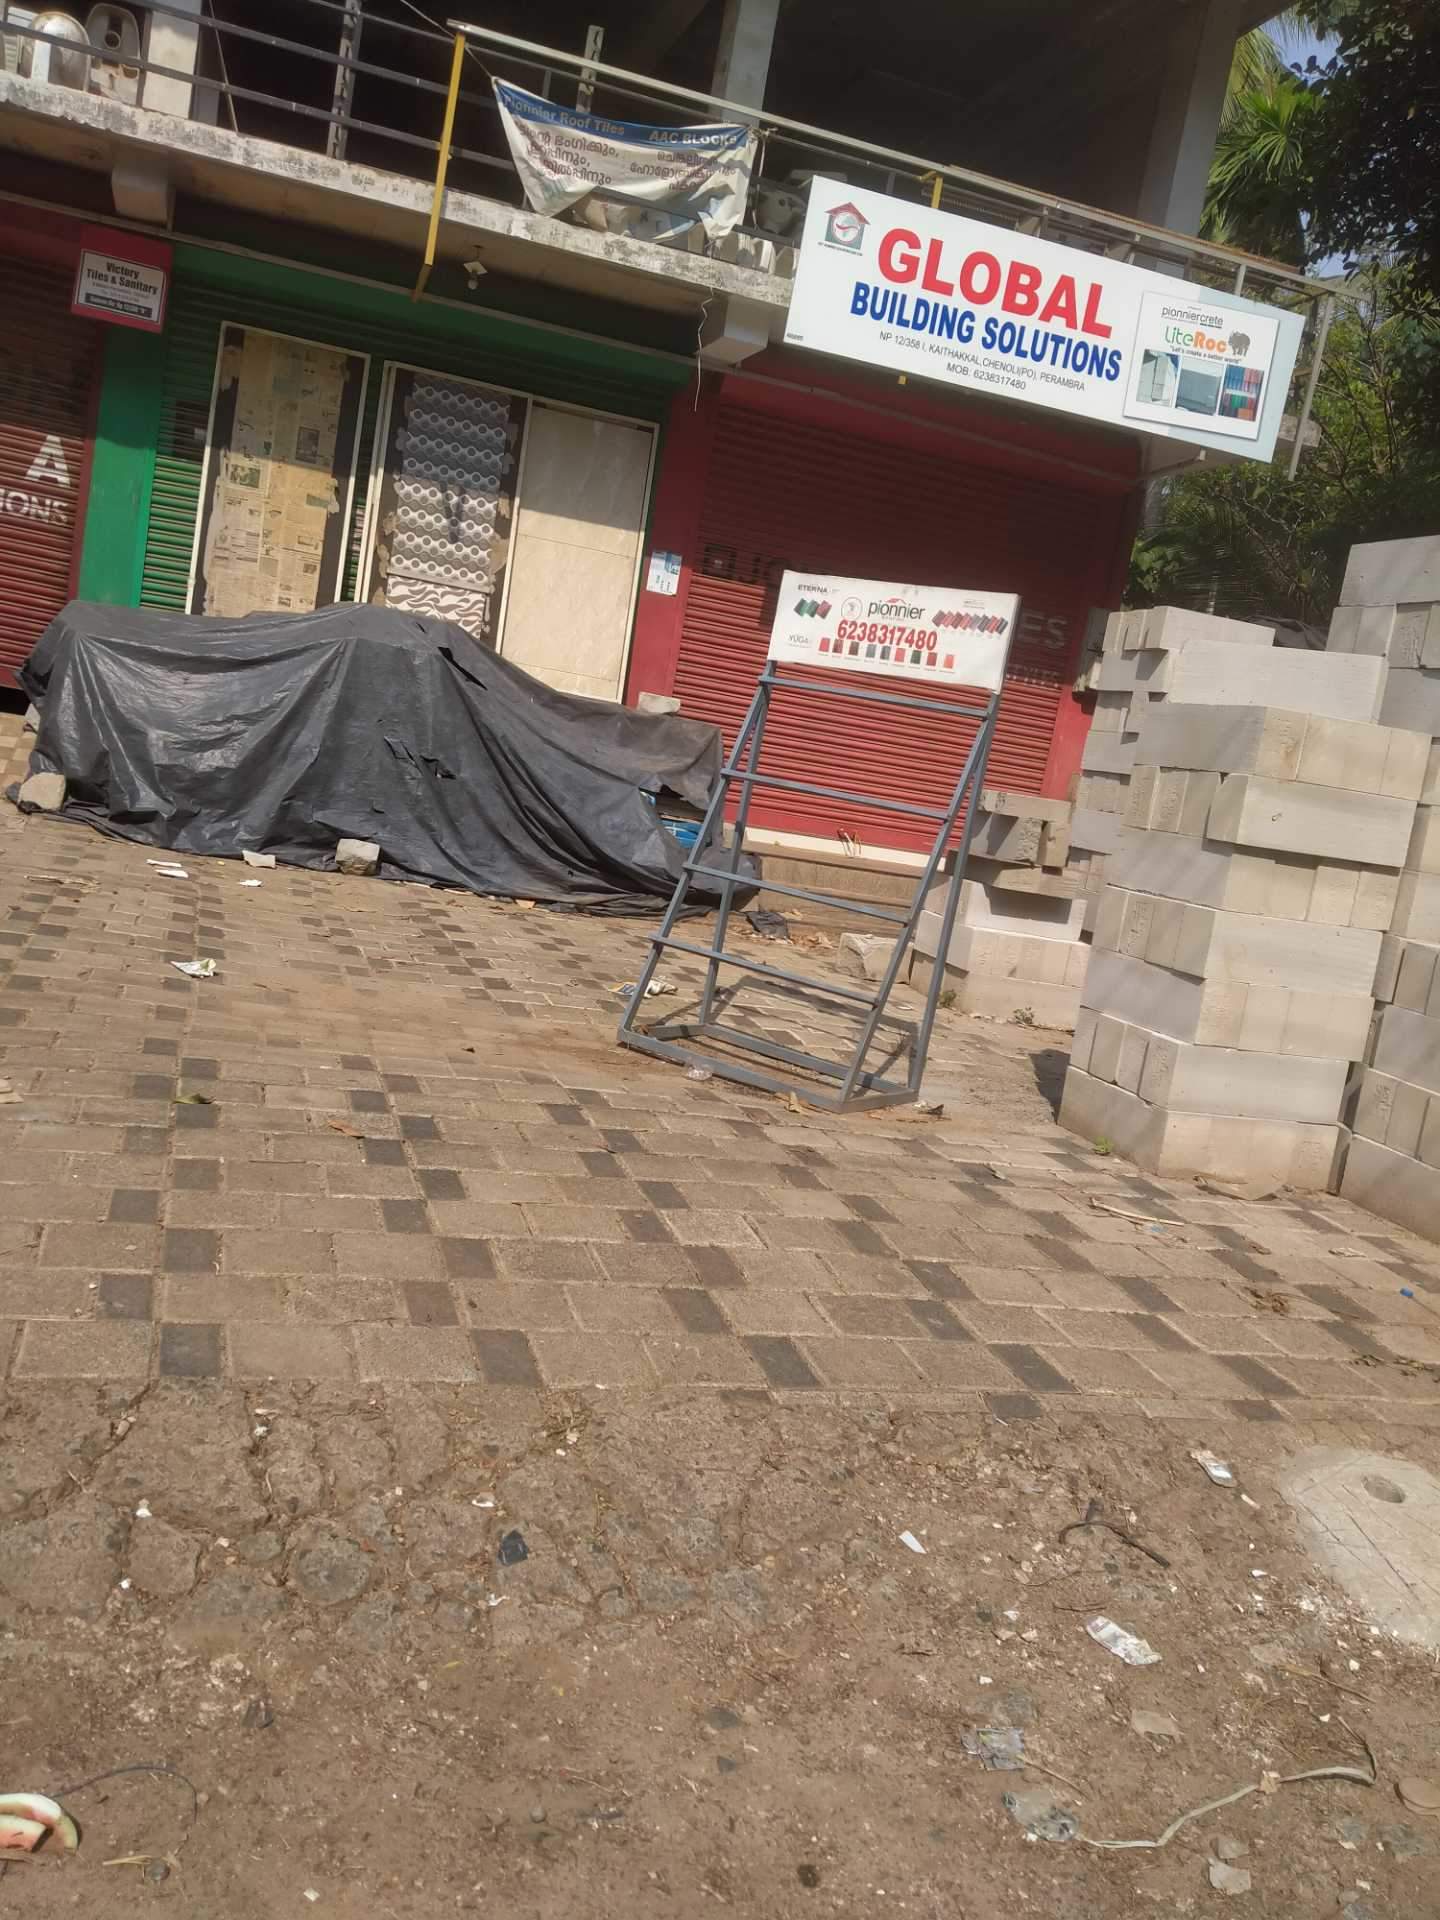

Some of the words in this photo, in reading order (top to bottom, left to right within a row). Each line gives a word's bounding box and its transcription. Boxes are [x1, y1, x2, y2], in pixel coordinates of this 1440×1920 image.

[560, 111, 590, 129] Roof
[594, 118, 625, 136] Tiles
[649, 130, 679, 144] AAC
[87, 268, 109, 282] Tiles
[111, 275, 117, 285] &
[119, 276, 159, 295] Sanitary
[106, 262, 139, 279] Victory
[878, 228, 1113, 339] GLOBAL
[1161, 306, 1224, 326] pionniercrete
[850, 281, 976, 344] BUILDING
[981, 317, 1122, 381] SOLUTIONS
[879, 331, 893, 342] NP
[895, 334, 921, 349] 12/358
[1040, 373, 1085, 391] PERAMBRA
[974, 369, 1027, 391] 6238317480
[798, 584, 828, 593] ETERNA
[868, 600, 925, 620] pionnier
[838, 619, 938, 651] 6238317480
